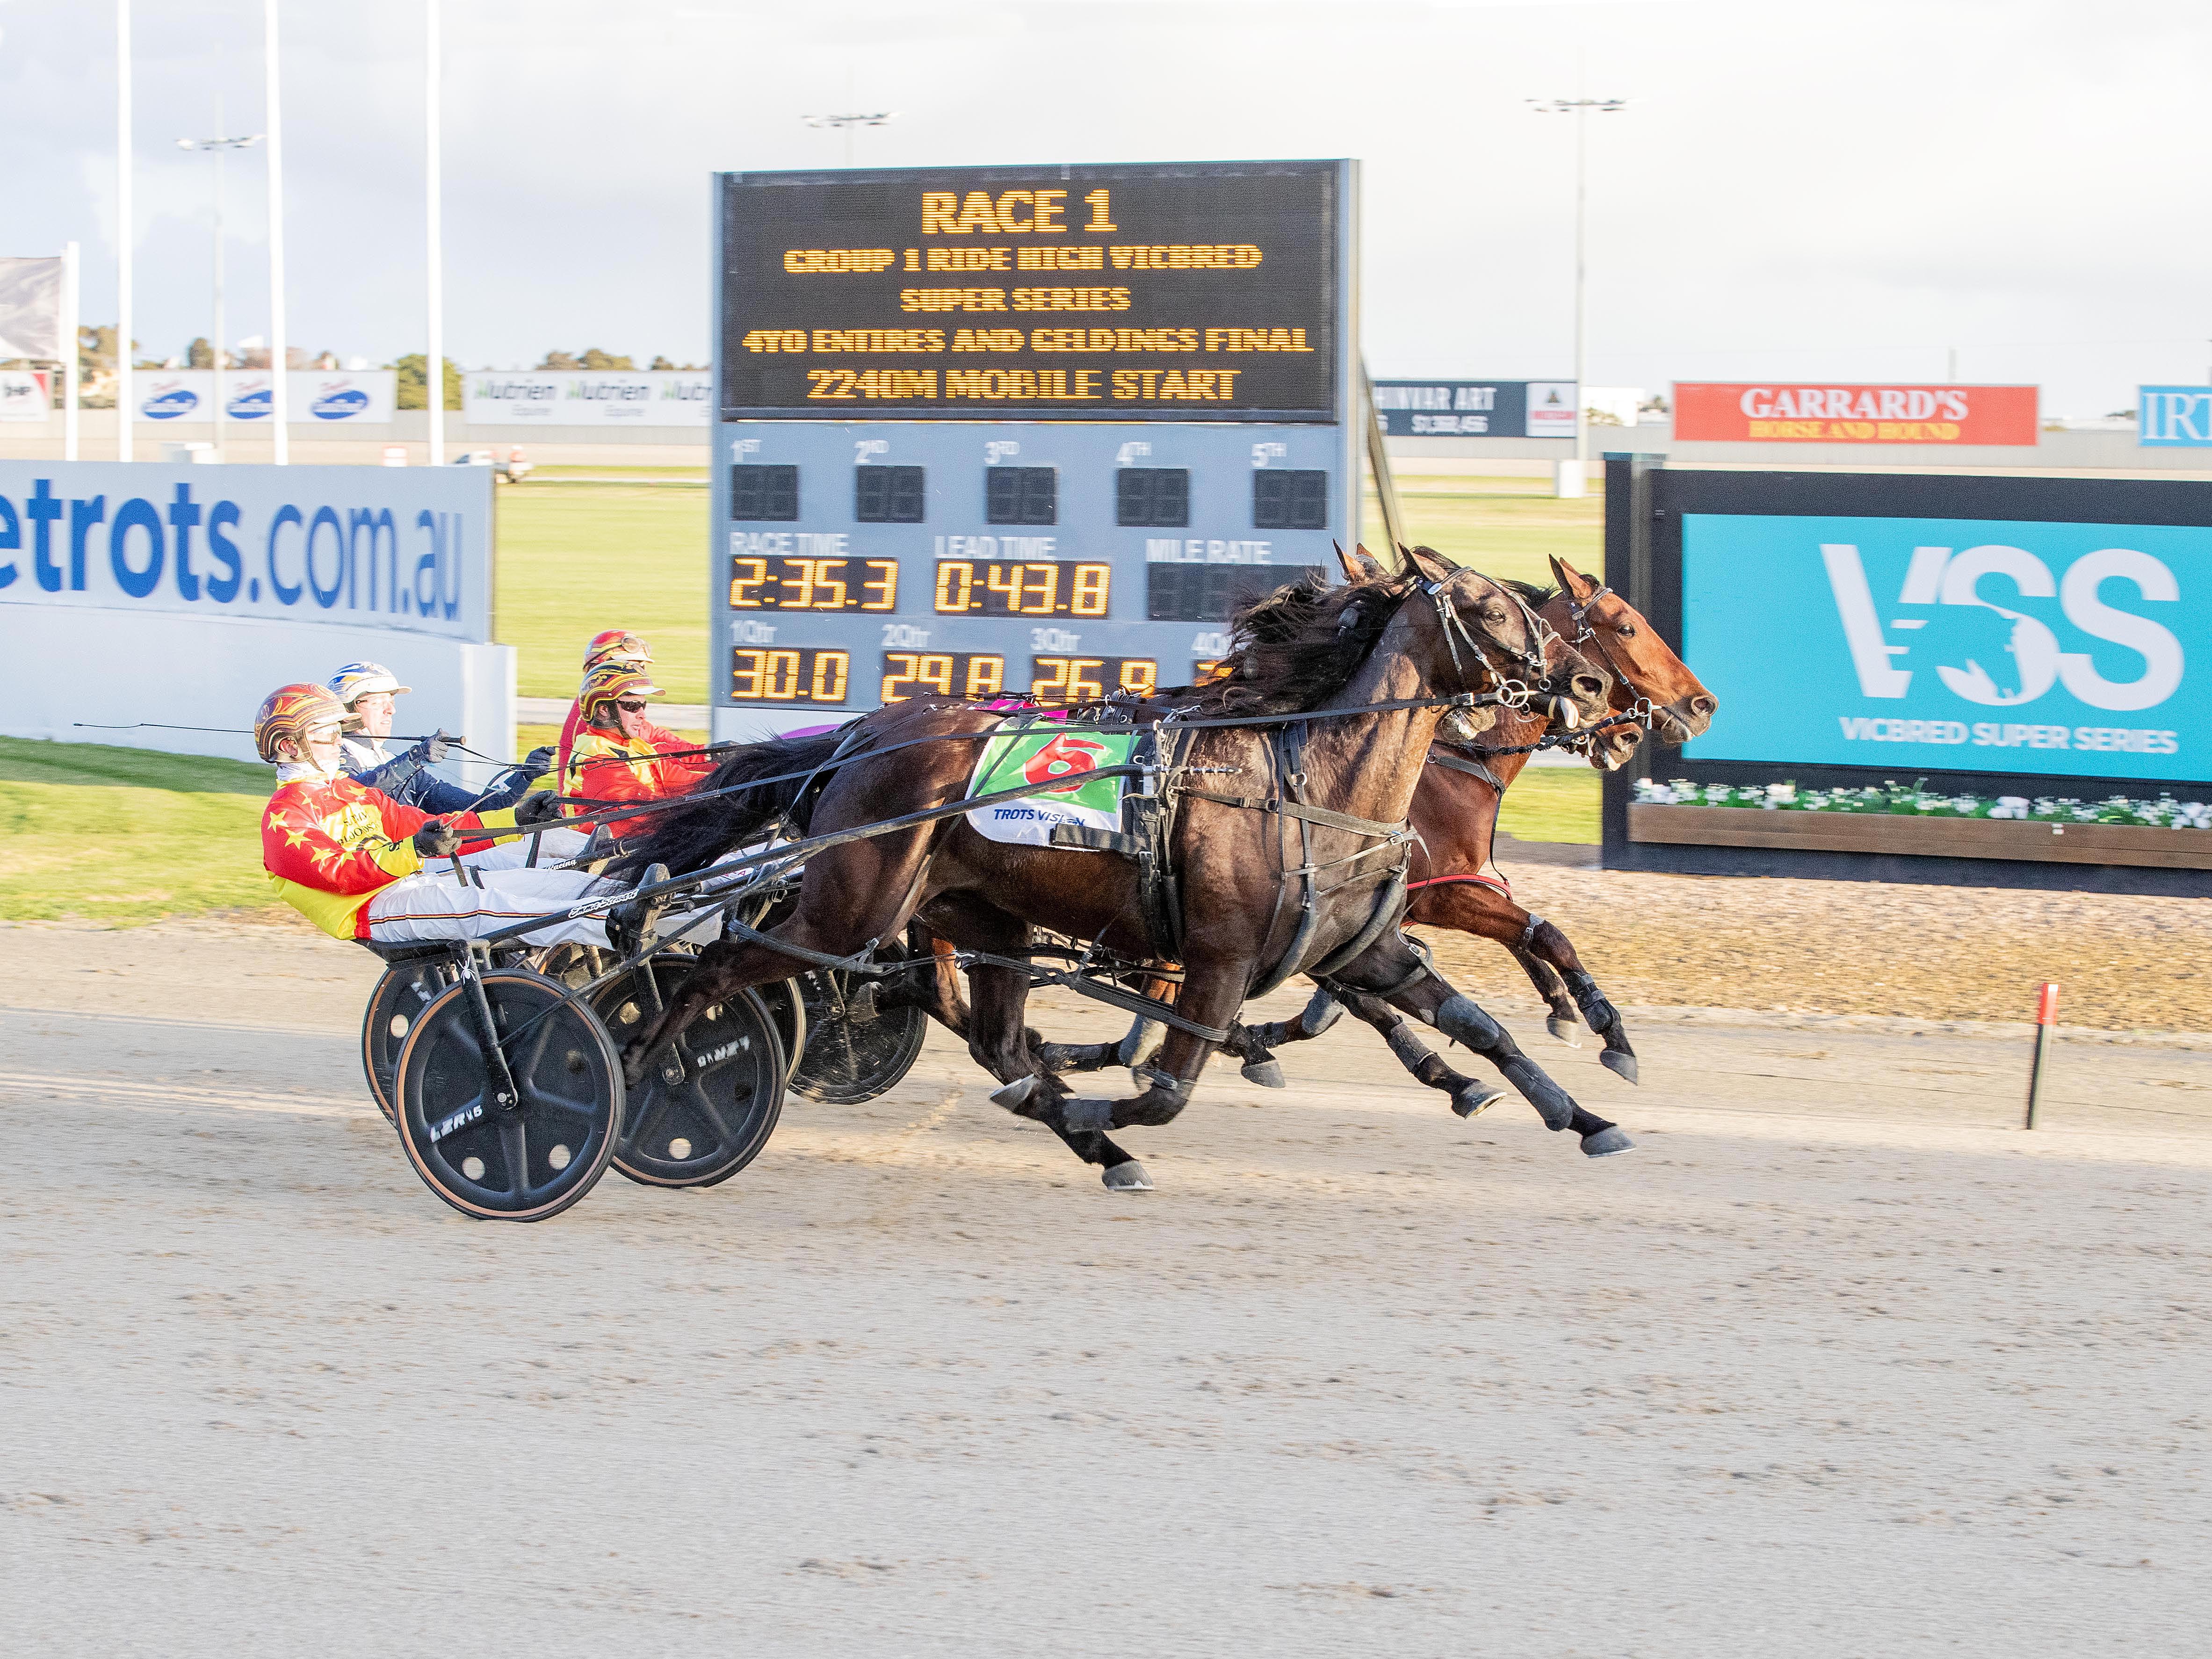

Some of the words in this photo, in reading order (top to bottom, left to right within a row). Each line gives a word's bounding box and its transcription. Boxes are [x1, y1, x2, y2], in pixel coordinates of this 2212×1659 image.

[922, 190, 1068, 234] RACE
[1084, 189, 1118, 232] 1
[783, 249, 895, 273] GROUP
[903, 248, 922, 272] 1
[927, 247, 1012, 271] RIDE
[1017, 246, 1103, 270] HIGH
[1109, 245, 1263, 269] VICBRED
[900, 288, 1009, 312] SUPER
[1011, 287, 1131, 311] SERIES
[812, 329, 946, 353] ENTIRES
[951, 329, 1025, 352] AND
[1030, 328, 1199, 352] GELDINGS
[1205, 328, 1315, 352] FINAL
[807, 369, 938, 399] 2240M
[946, 369, 1102, 399] MOBILE
[1111, 370, 1242, 400] START
[1740, 387, 1969, 420] GARRARD'S
[1827, 422, 1875, 440] AND
[730, 532, 792, 555] RACE
[795, 533, 850, 556] TIME
[934, 535, 998, 559] LEAD
[1000, 536, 1057, 560] TIME
[1146, 538, 1206, 562] MILE
[1207, 540, 1272, 563] RATE
[729, 558, 899, 611] 2:35.3
[935, 561, 1111, 615] 0:43.8
[1819, 543, 2184, 711] VSS
[731, 649, 850, 701] 30.0
[1838, 716, 1969, 745] VICBRED
[1972, 722, 2071, 749] SUPER
[2073, 726, 2179, 754] SERIES
[1024, 732, 1107, 794] 6
[994, 809, 1034, 820] TROTS
